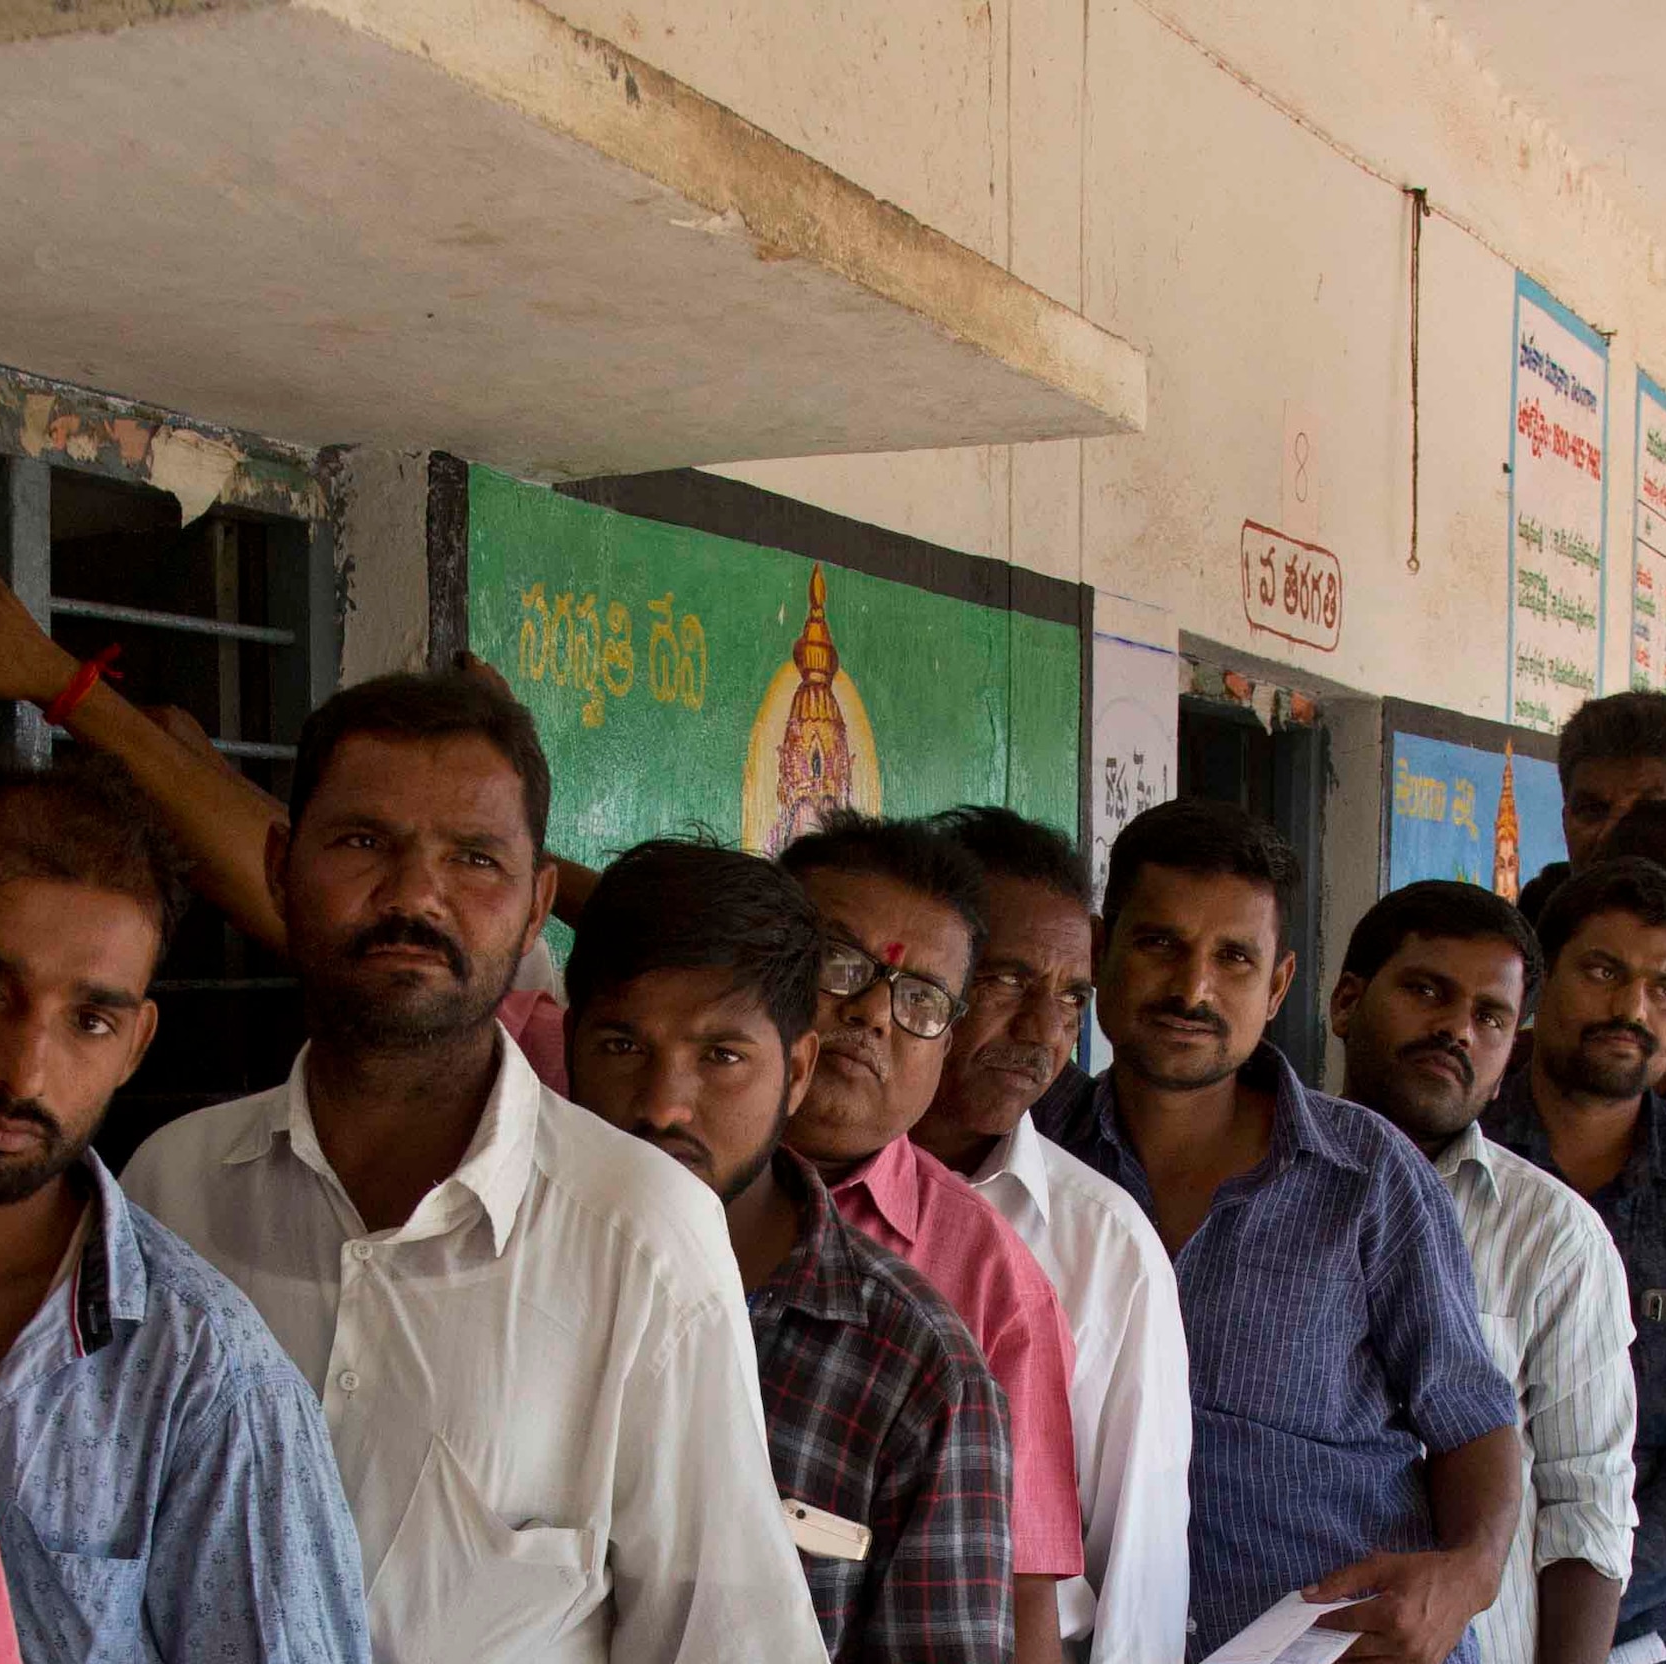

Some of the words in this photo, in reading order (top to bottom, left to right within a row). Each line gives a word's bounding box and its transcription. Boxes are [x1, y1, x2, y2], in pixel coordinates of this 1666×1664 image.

[1259, 545, 1276, 607] వ
[1283, 552, 1338, 630] తరగతి
[518, 582, 635, 729] సరస్వతి
[647, 590, 708, 713] దేవి
